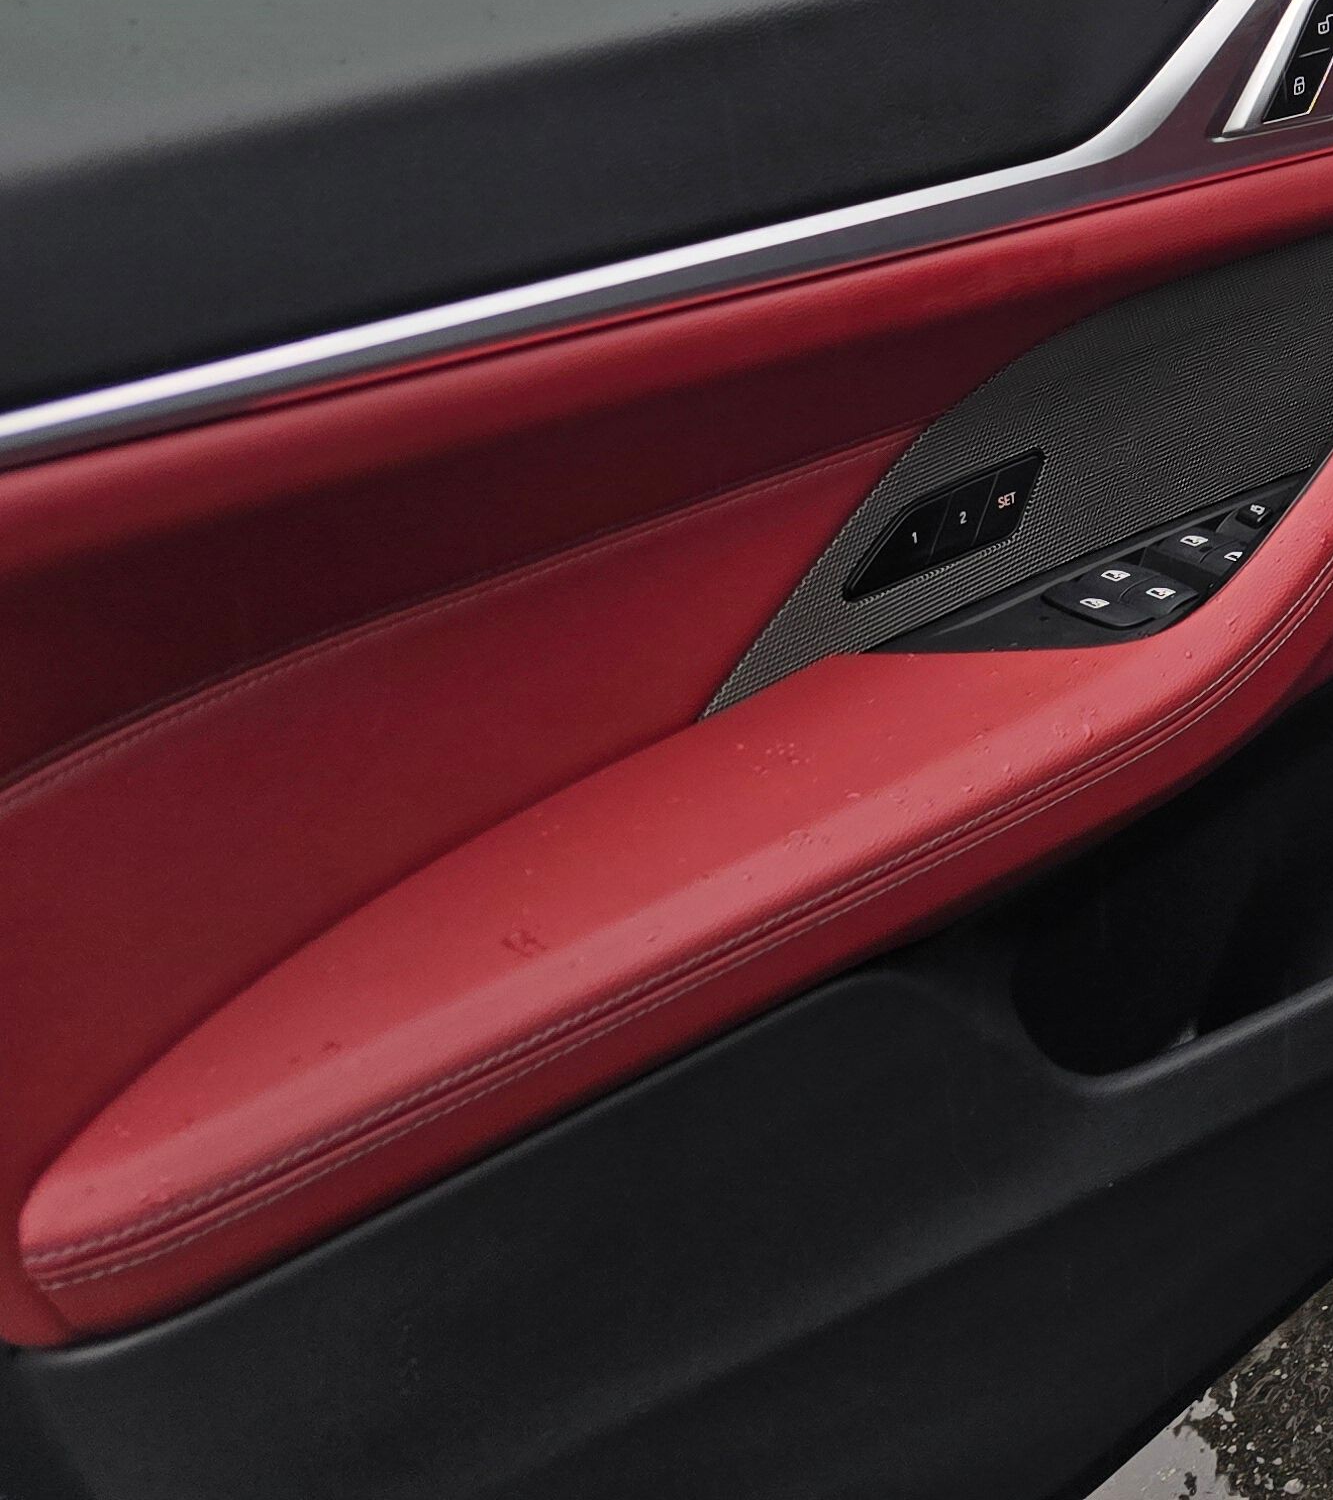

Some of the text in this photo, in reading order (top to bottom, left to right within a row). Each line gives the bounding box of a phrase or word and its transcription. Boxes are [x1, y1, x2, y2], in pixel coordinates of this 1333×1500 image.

[911, 491, 1017, 544] 1 2 SET
